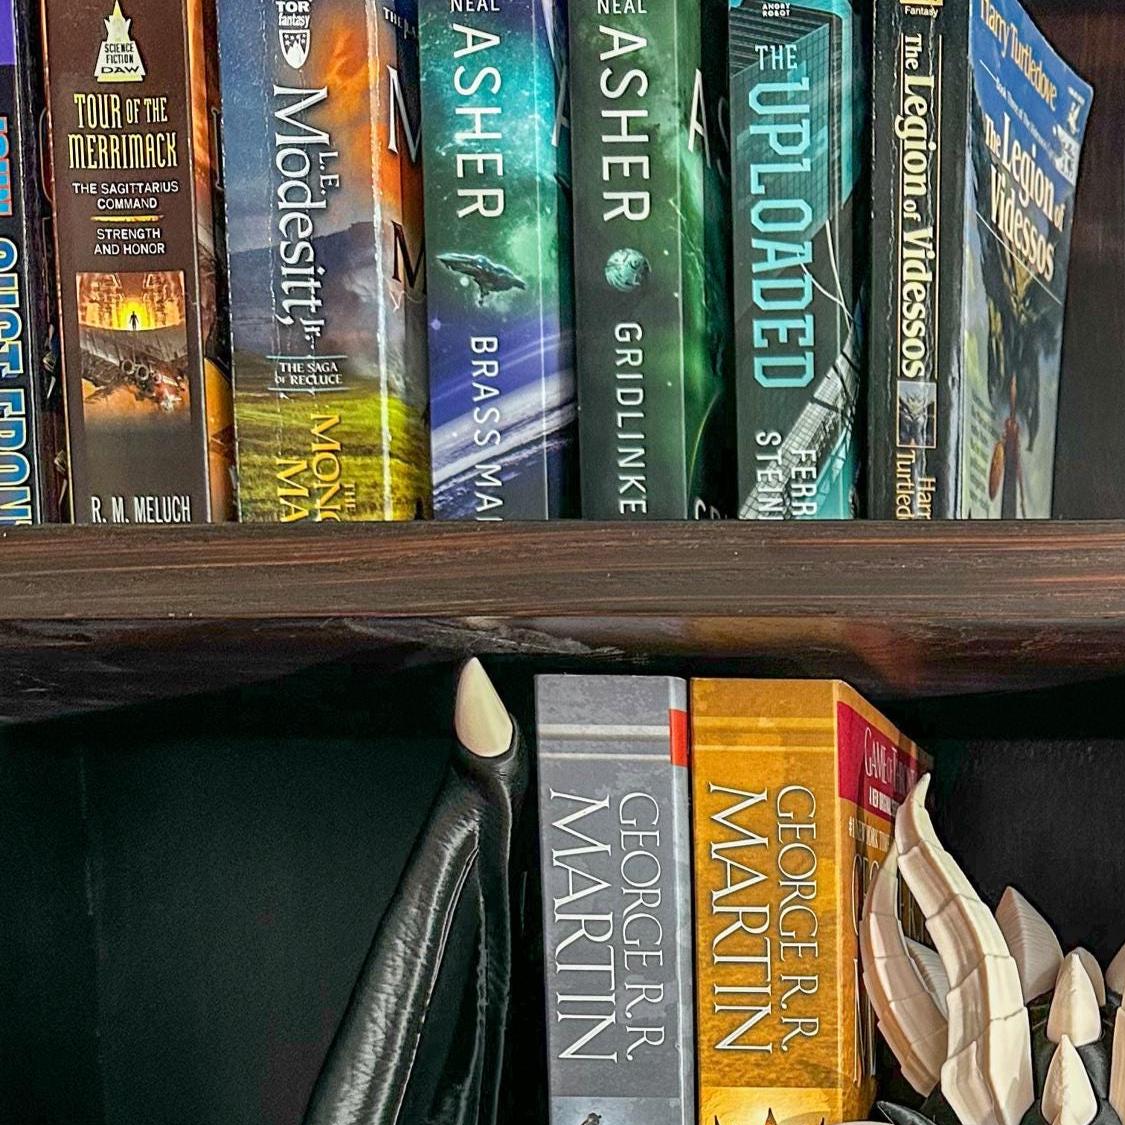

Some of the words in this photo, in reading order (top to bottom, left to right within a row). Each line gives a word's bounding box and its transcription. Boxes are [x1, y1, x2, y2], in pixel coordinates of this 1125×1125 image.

[275, 1, 309, 12] TOR
[278, 13, 310, 28] fantasy
[450, 0, 499, 12] NEAL
[598, 0, 647, 14] NEAL
[904, 5, 939, 18] Fantasy
[105, 43, 134, 53] SCIENCE
[106, 54, 134, 64] FICTION
[755, 44, 798, 70] THE
[905, 33, 922, 70] The
[101, 66, 140, 74] DAW
[1010, 19, 1057, 111] Turtledove
[74, 94, 122, 129] TOUR
[126, 98, 140, 124] OF
[144, 96, 168, 123] THE
[453, 23, 504, 219] ASHER
[599, 24, 652, 222] ASHER
[895, 73, 937, 198] Legion
[68, 133, 178, 170] MERRIMACK
[984, 113, 1001, 157] The
[1003, 112, 1055, 220] Legion
[1055, 204, 1067, 232] of
[72, 182, 98, 195] THE
[101, 181, 179, 194] SAGITTARIUS
[97, 198, 157, 210] COMMAND
[903, 200, 920, 222] of
[97, 228, 161, 241] STRENGTH
[748, 76, 816, 389] UPLOADED
[990, 163, 1055, 282] Videssos
[94, 243, 120, 255] AND
[123, 242, 165, 255] HONOR
[902, 223, 936, 377] Videssos
[279, 362, 305, 374] THE
[309, 363, 339, 373] SAGA
[290, 374, 343, 385] RECLUCE
[470, 336, 501, 447] BRASS
[344, 483, 356, 513] THE
[474, 464, 503, 521] MA
[91, 497, 107, 522] R.
[112, 497, 129, 522] M.
[133, 496, 192, 522] MELUCH
[619, 791, 664, 971] GEORGE
[777, 785, 819, 961] GEORGE
[549, 788, 618, 1064] MARTIN
[709, 781, 773, 1055] MARTIN
